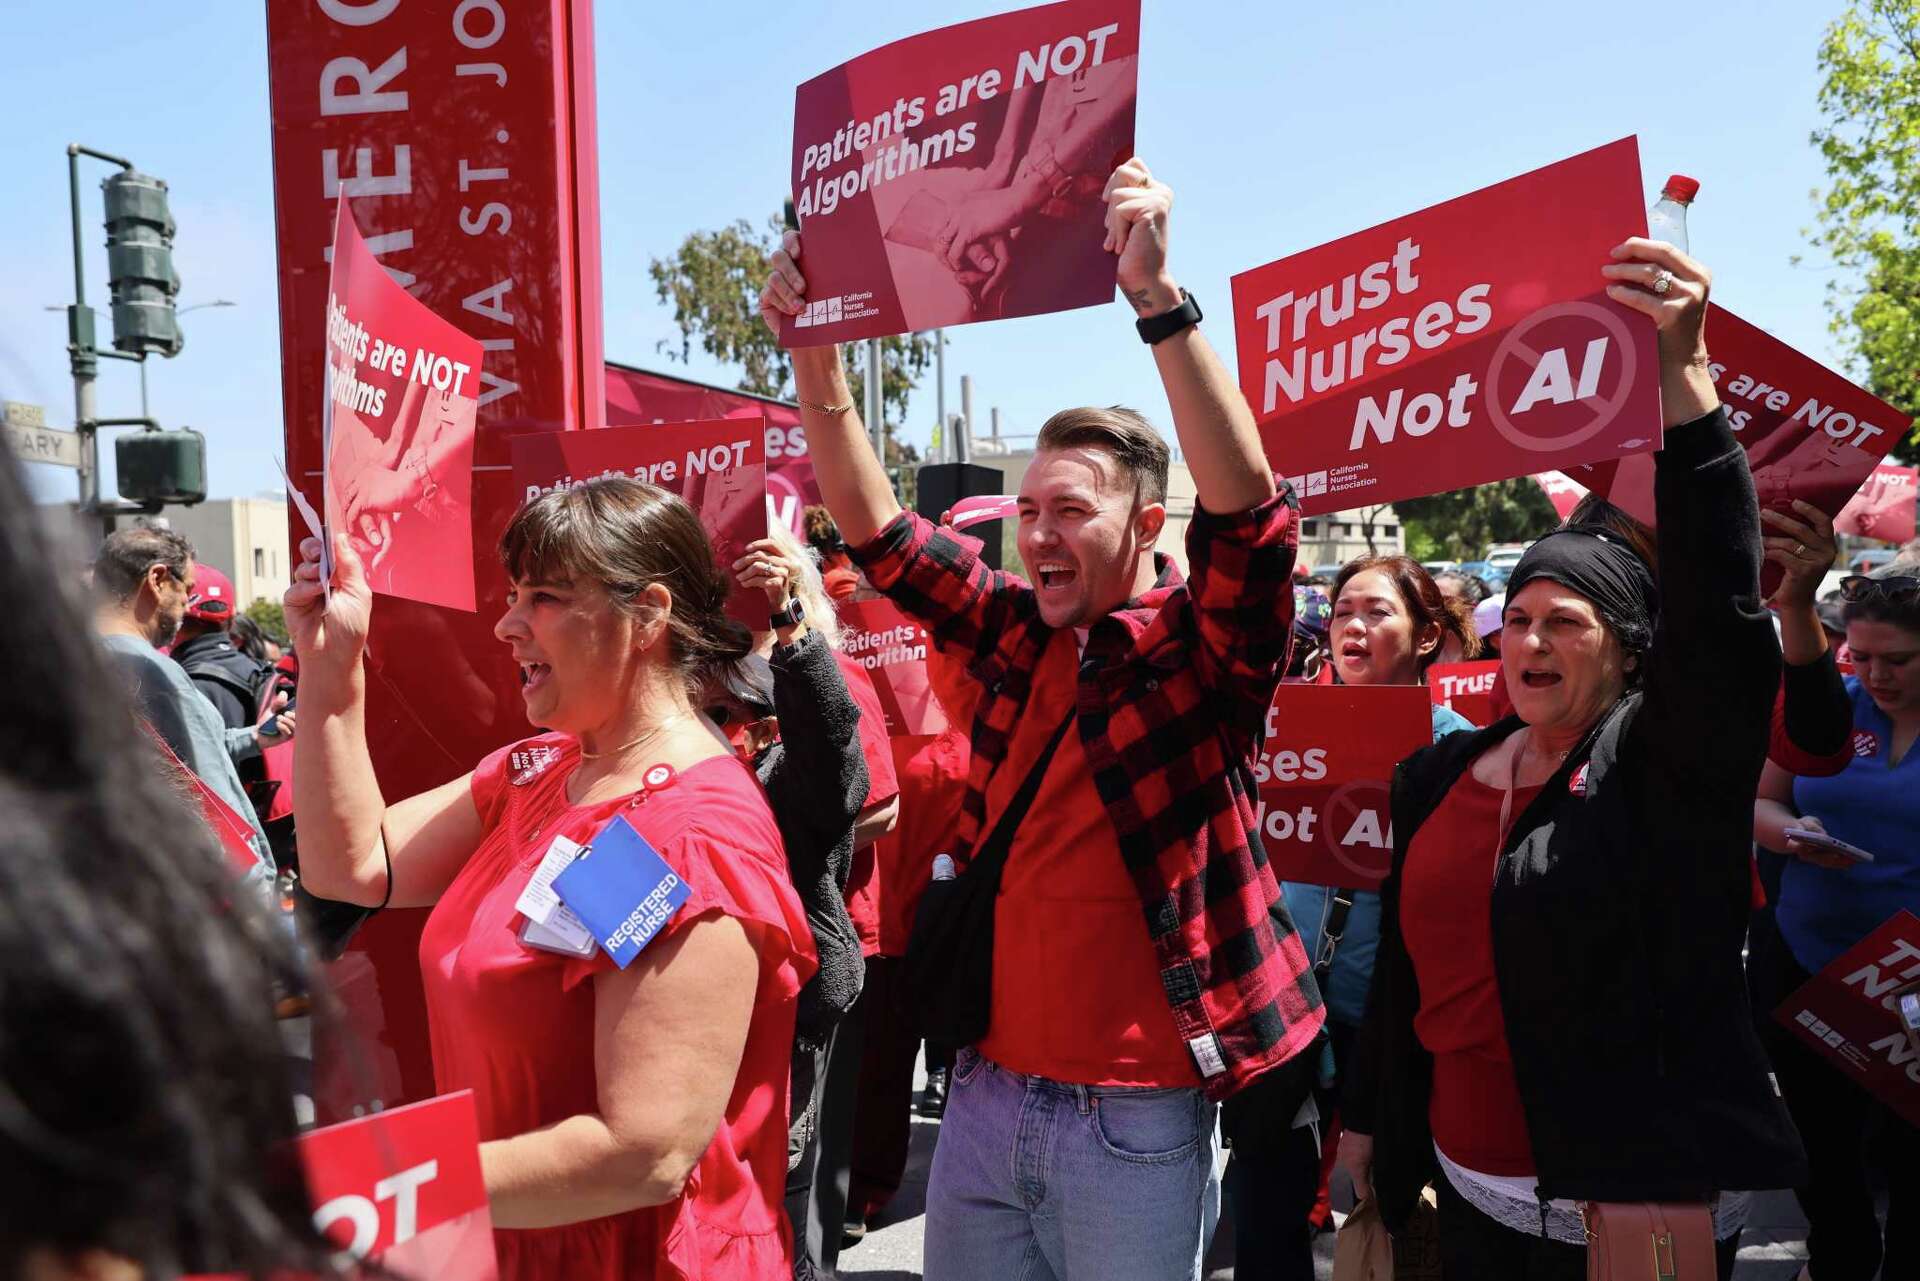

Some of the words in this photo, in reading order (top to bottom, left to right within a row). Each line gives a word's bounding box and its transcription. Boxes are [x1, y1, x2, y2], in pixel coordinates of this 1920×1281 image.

[800, 96, 925, 182] Patients
[935, 68, 1001, 116] are
[1013, 23, 1119, 90] NOT
[458, 129, 513, 236] ST.
[798, 121, 977, 217] Algorithms
[843, 291, 873, 303] California
[844, 302, 864, 311] Nurses
[844, 308, 880, 320] Association
[1256, 237, 1420, 354] Trust
[370, 338, 407, 377] are
[409, 348, 471, 397] NOT
[461, 277, 520, 408] VIA
[1263, 283, 1492, 414] Nurses
[1349, 373, 1478, 450] Not
[1510, 336, 1609, 415] AI
[1727, 374, 1791, 411] are
[1792, 398, 1884, 448] NOT
[634, 460, 677, 485] are
[685, 440, 751, 477] NOT
[1330, 462, 1369, 476] California
[1330, 473, 1357, 484] Nurses
[1330, 478, 1377, 492] Association
[605, 872, 679, 953] REGISTERED
[630, 899, 675, 947] NURSE
